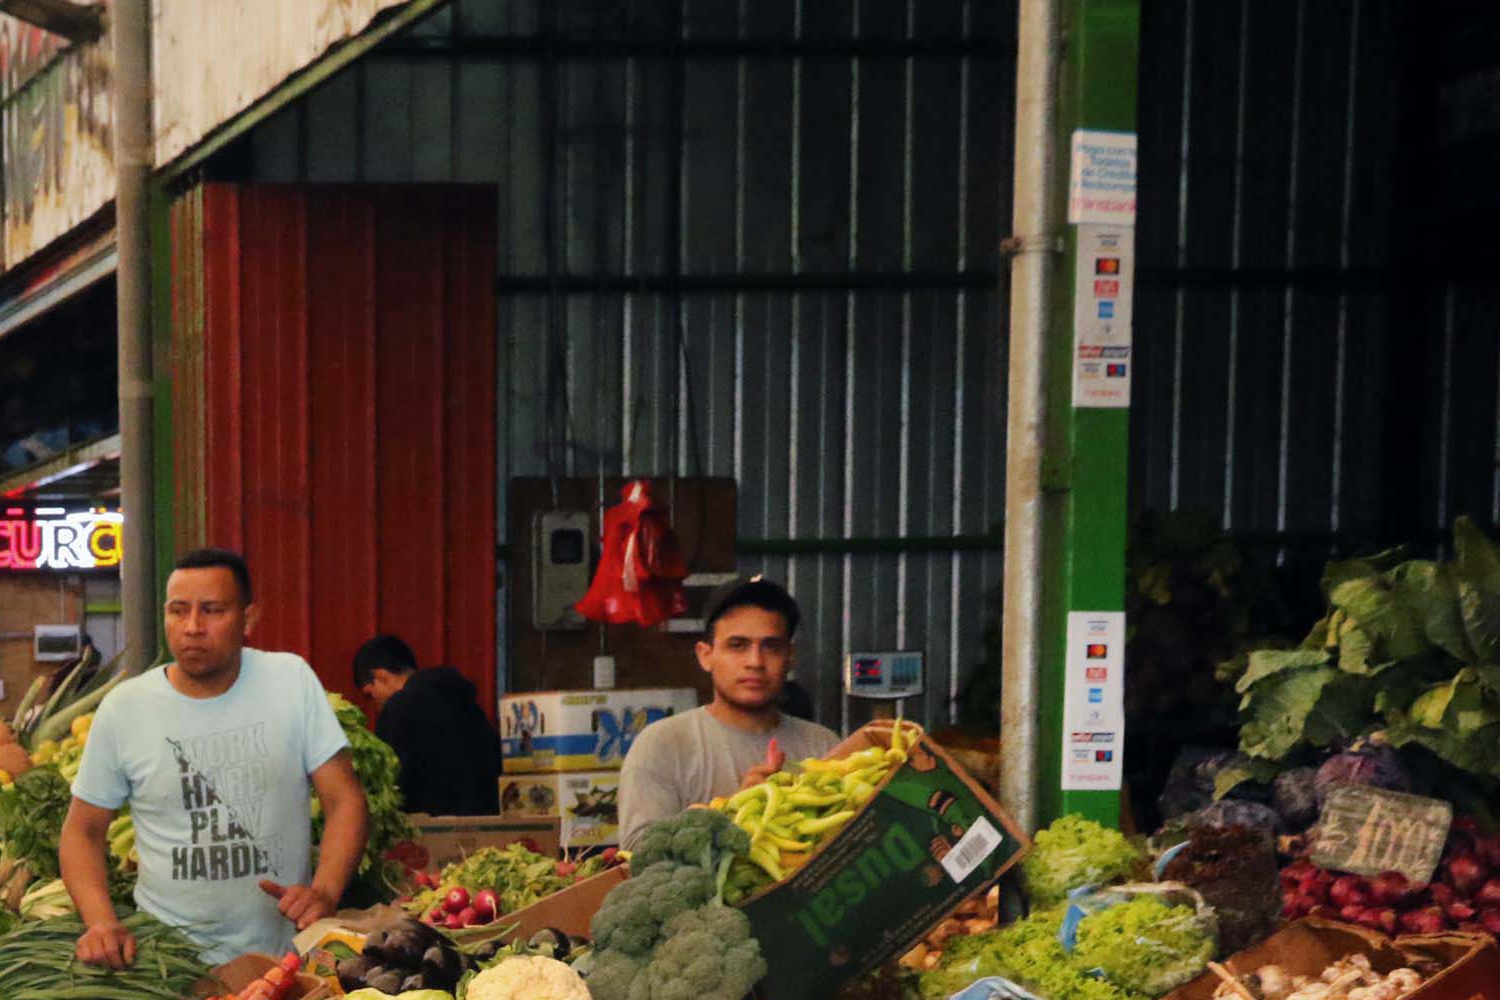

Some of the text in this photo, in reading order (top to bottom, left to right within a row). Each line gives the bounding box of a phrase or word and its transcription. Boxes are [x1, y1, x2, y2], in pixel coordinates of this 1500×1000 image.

[181, 765, 268, 811] HARD
[190, 802, 262, 845] PLAY
[799, 821, 925, 947] Dusal
